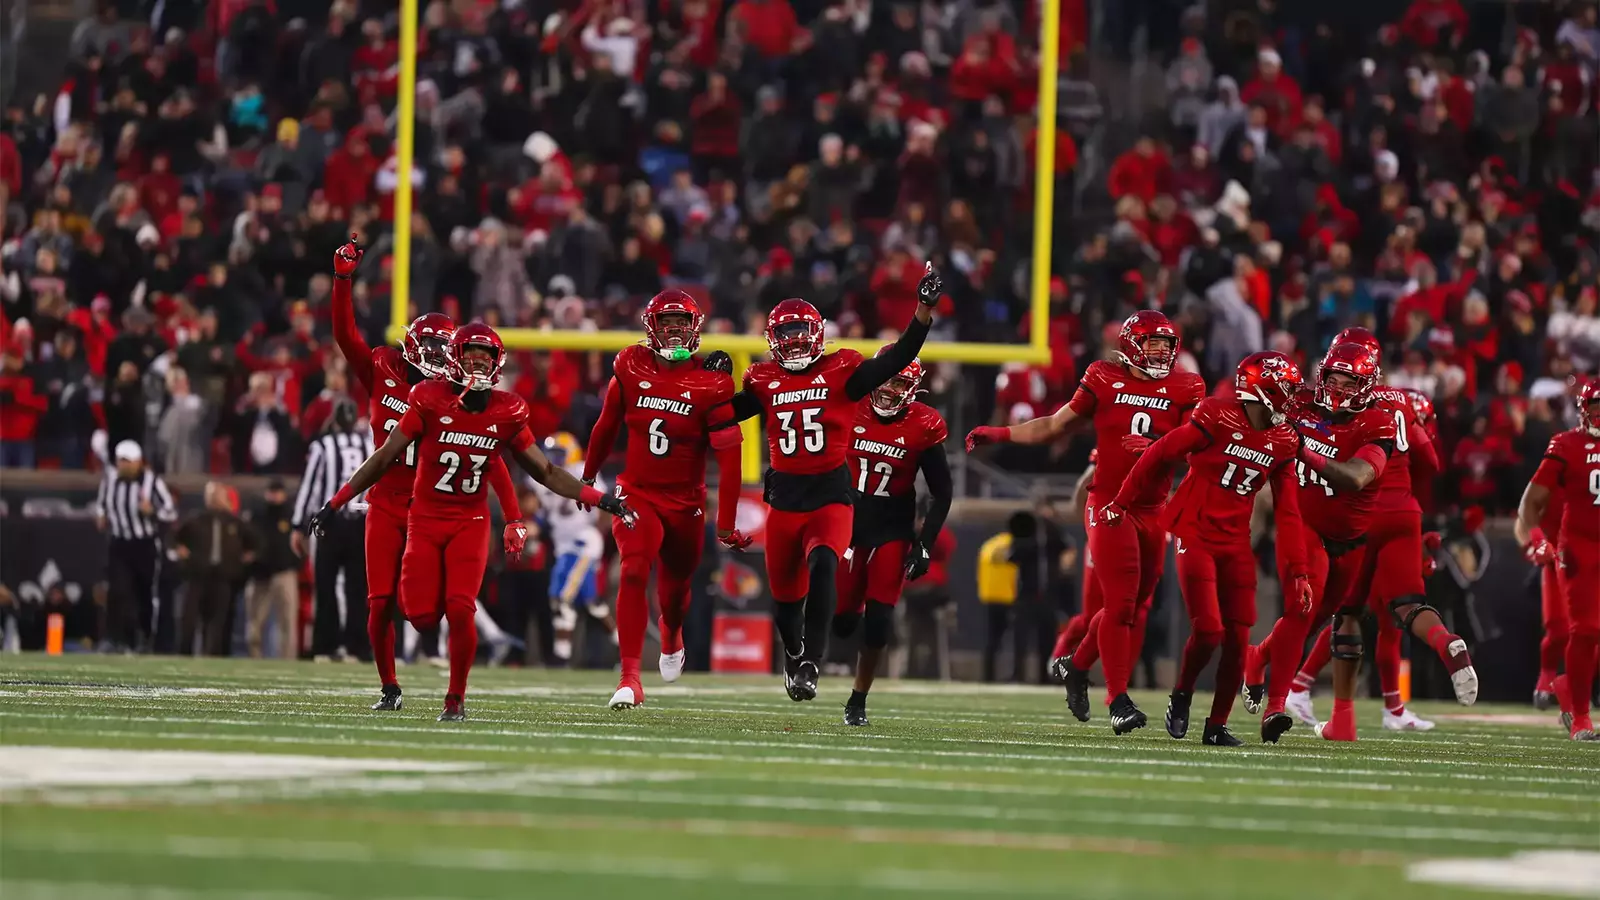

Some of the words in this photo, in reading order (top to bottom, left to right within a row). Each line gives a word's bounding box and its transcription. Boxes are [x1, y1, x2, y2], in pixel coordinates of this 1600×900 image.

[381, 394, 411, 414] LOUIS
[636, 395, 693, 416] LOUISVILLE
[772, 388, 829, 407] LOUISVILLE
[1114, 393, 1171, 410] LOUISVILLE
[438, 431, 500, 450] LOUISVILLE
[649, 418, 669, 455] 6
[776, 408, 824, 455] 35
[853, 438, 907, 459] LOUISVILLE
[1224, 443, 1275, 467] LOUISVILLE
[1303, 435, 1339, 459] UISVILLE
[434, 451, 488, 494] 23
[857, 457, 893, 497] 12
[1221, 462, 1260, 495] 13
